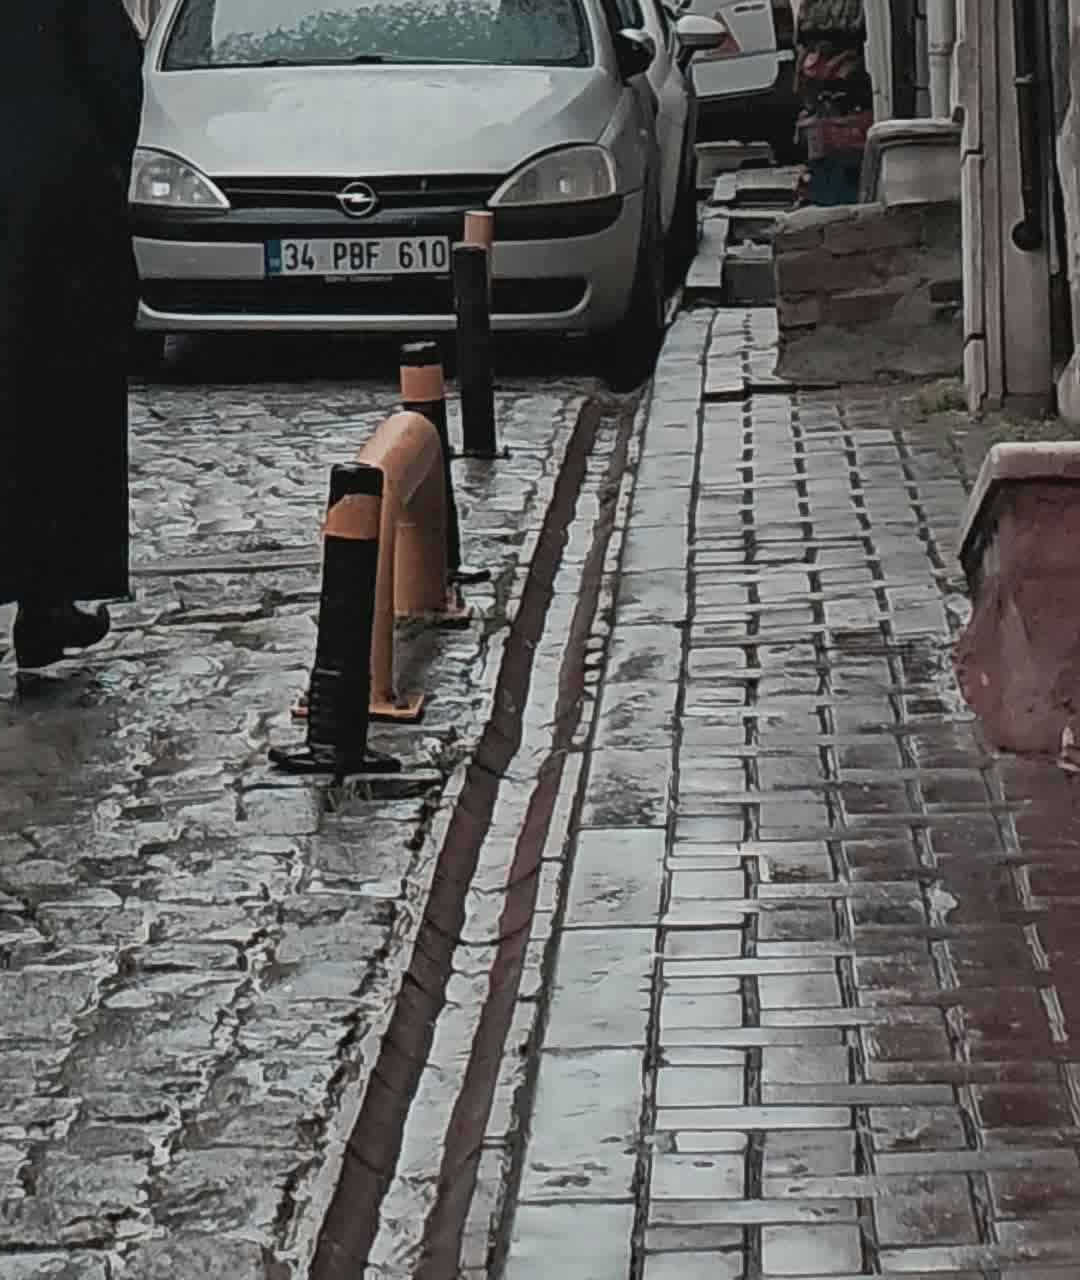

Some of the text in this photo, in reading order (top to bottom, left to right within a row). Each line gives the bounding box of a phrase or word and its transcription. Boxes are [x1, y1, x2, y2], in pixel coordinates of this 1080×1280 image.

[285, 240, 447, 271] 34 PBF 610
